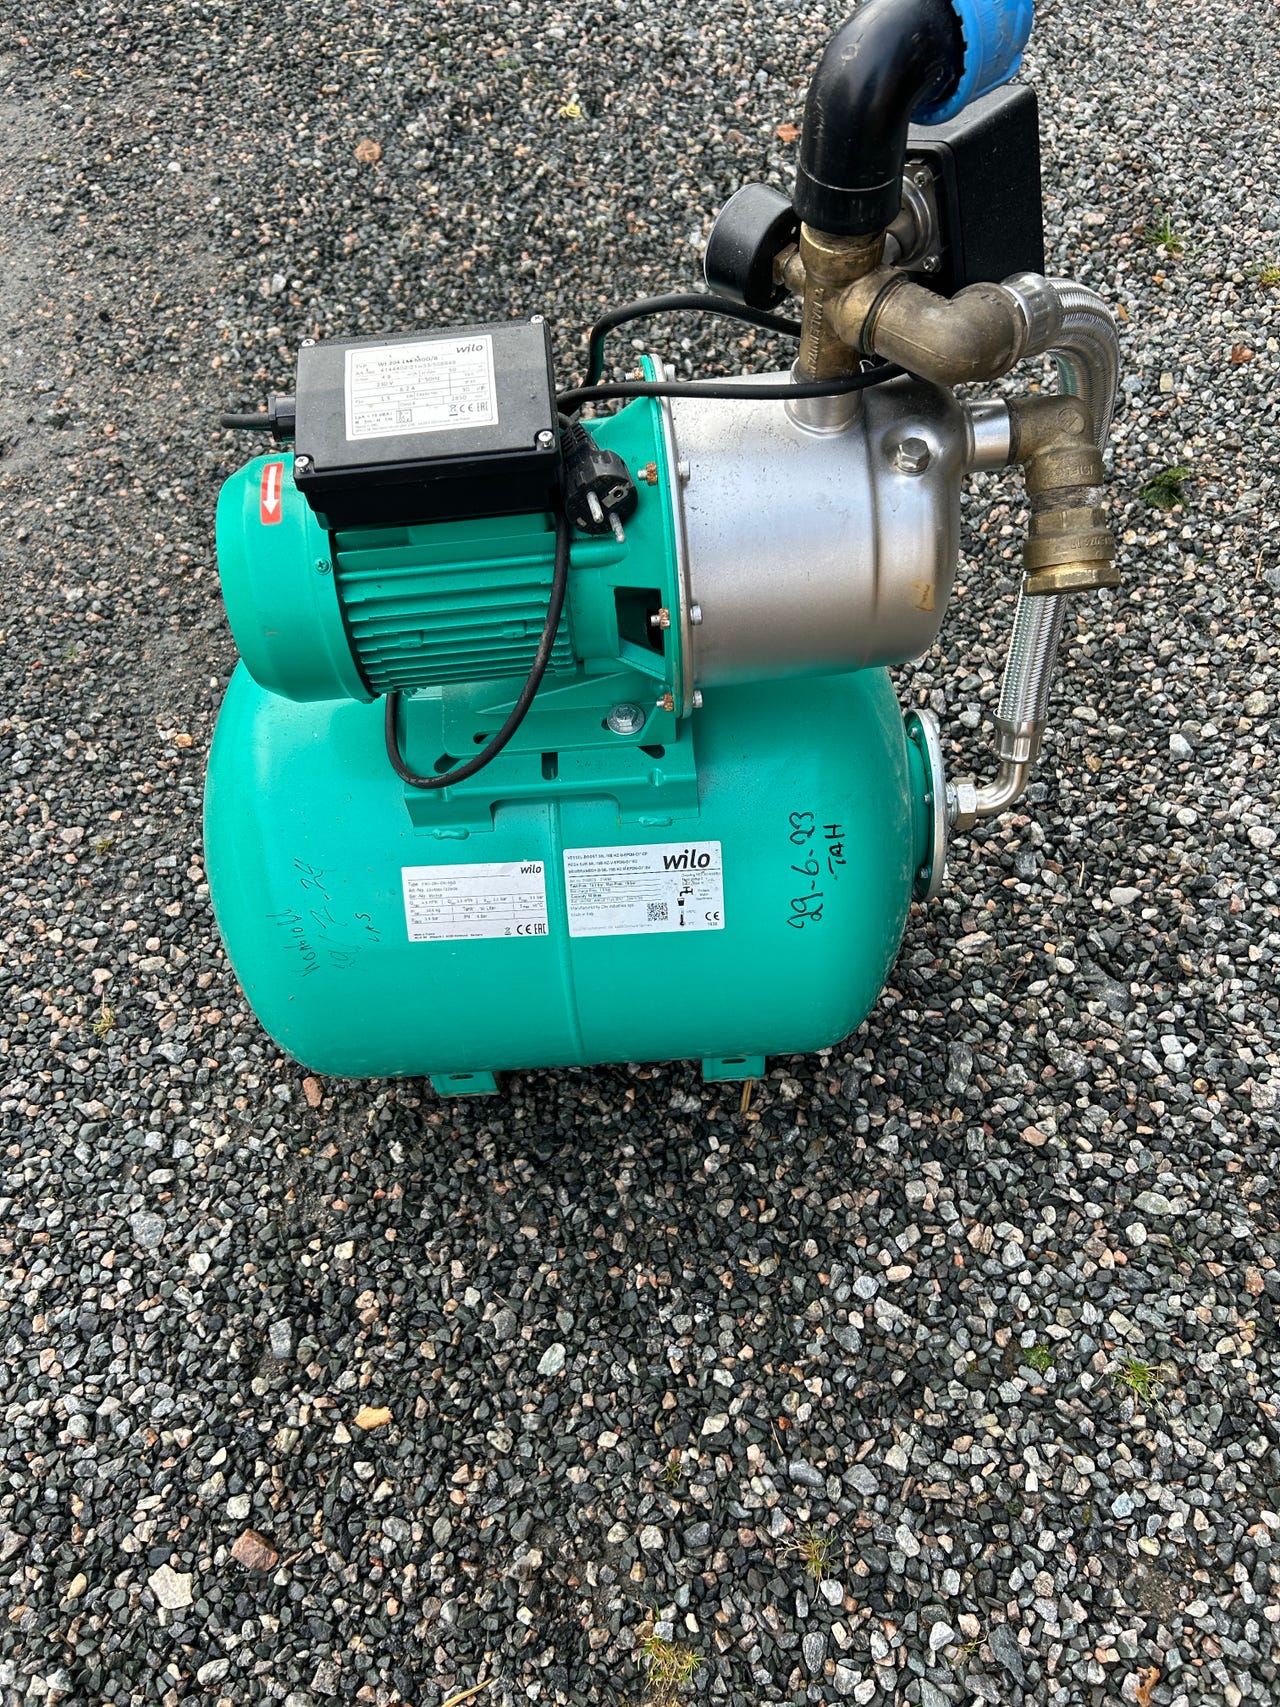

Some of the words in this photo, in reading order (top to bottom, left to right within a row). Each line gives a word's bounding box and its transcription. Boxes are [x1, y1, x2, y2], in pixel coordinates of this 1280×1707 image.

[456, 343, 484, 354] wilo
[663, 849, 711, 870] wilo
[520, 864, 542, 874] wilo
[787, 811, 824, 929] 29-6-23
